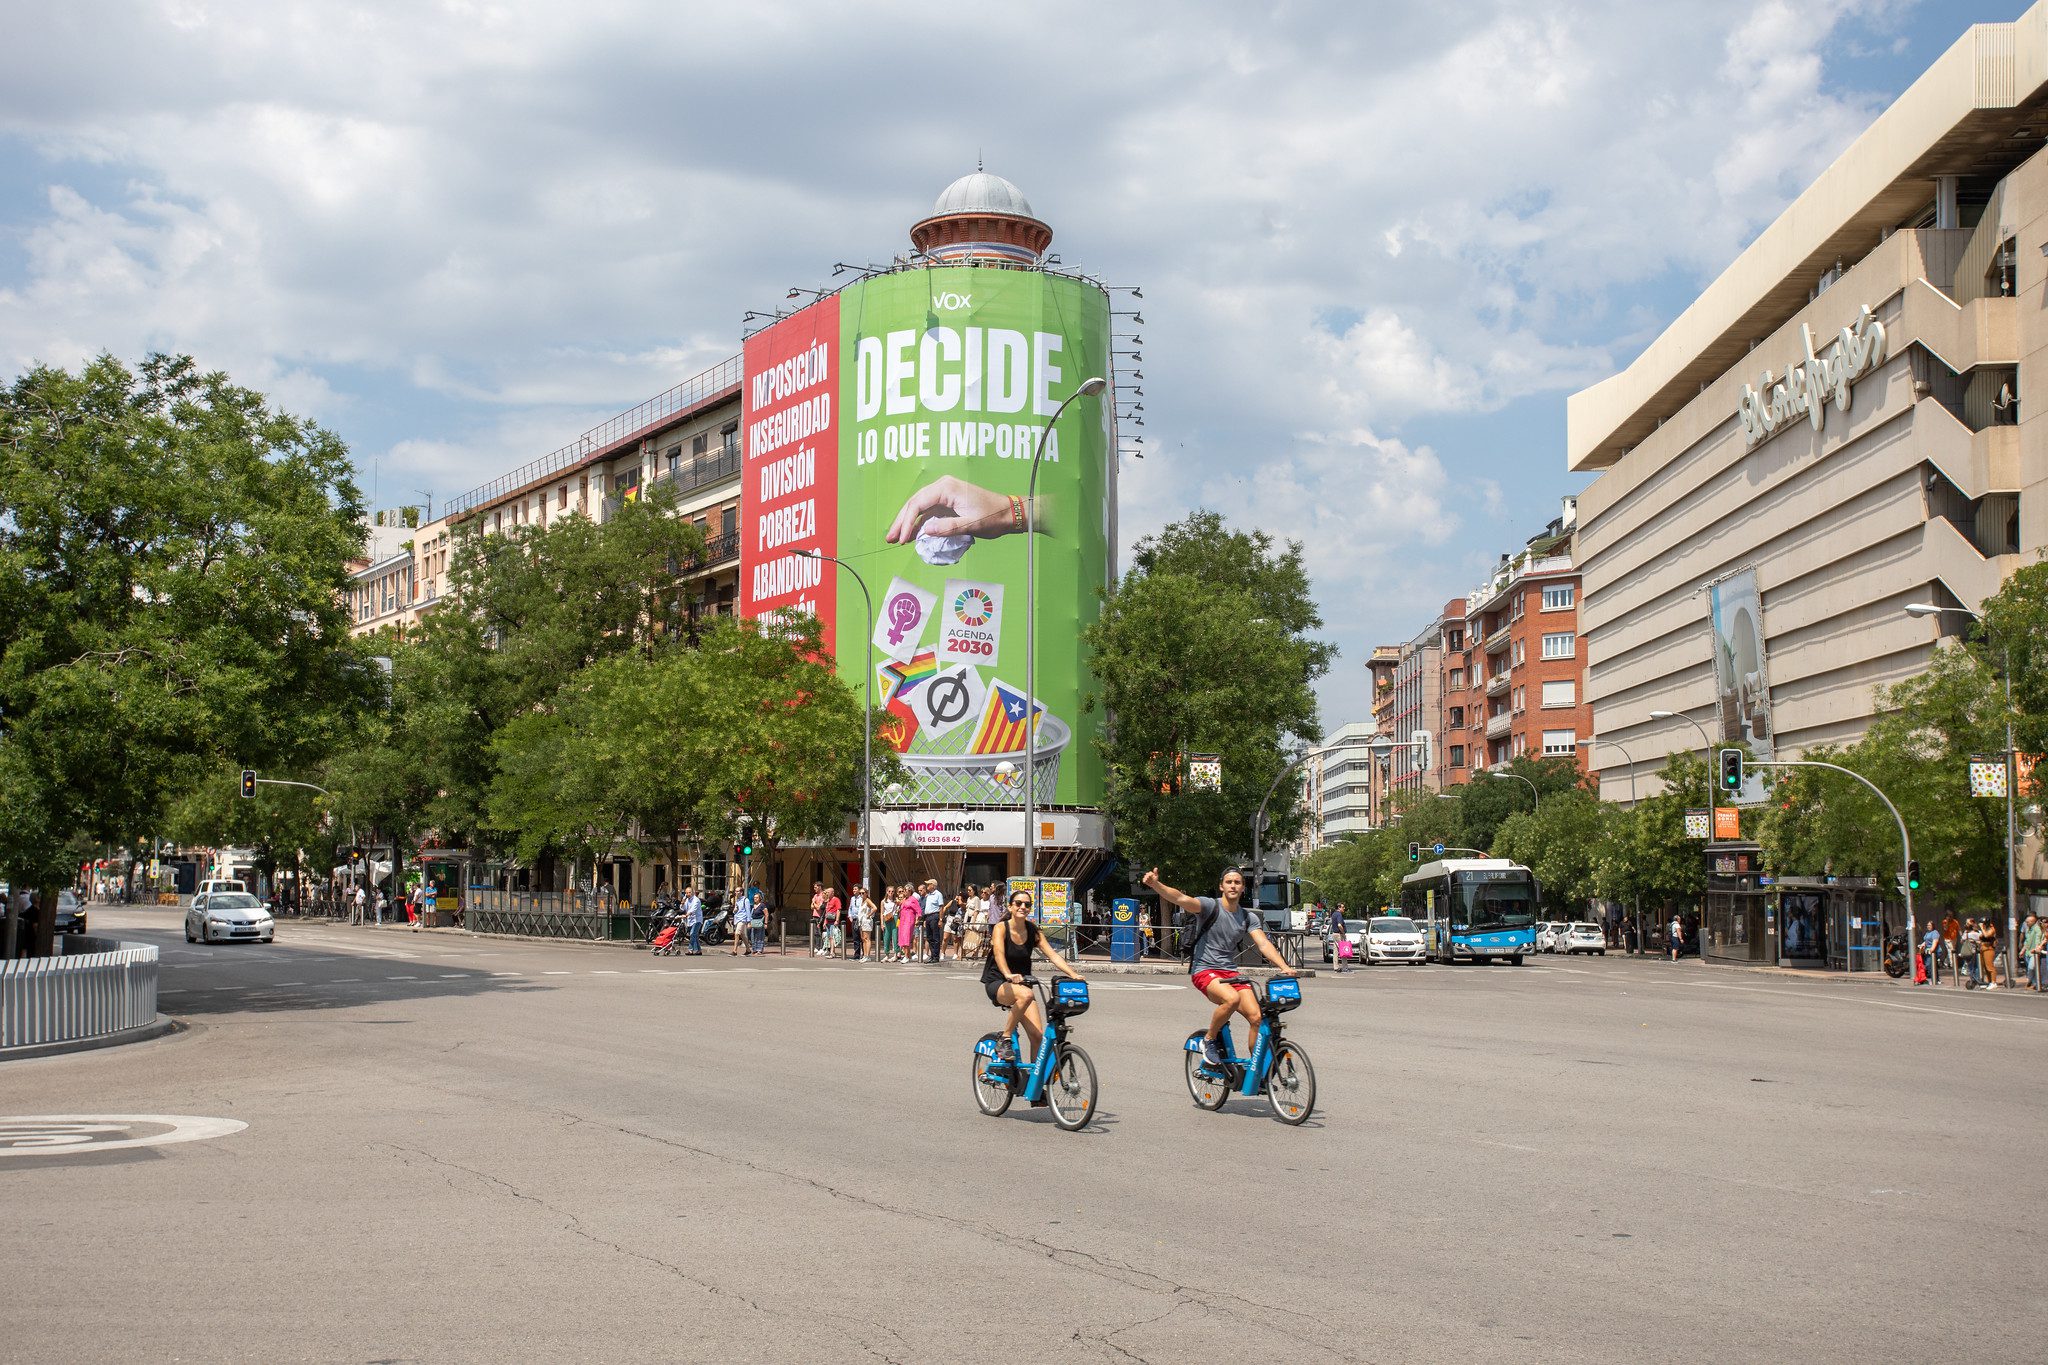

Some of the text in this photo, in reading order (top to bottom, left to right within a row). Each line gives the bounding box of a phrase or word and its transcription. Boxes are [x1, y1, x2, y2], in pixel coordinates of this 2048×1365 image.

[933, 291, 972, 311] VOX
[752, 338, 828, 412] IMPOSICIÓN
[857, 326, 1063, 422] DECIDE
[1757, 363, 1809, 432] Corte
[1800, 304, 1886, 432] Inglés
[749, 391, 830, 460] INSEGURIDAD
[858, 421, 1060, 466] LO QUE IMPORTA
[761, 442, 815, 504] DIVISIÓN
[759, 498, 816, 552] POBREZA
[752, 547, 822, 602] ABANDONO
[947, 639, 993, 656] 2030
[948, 629, 994, 641] AGENDA
[900, 819, 985, 833] pamdamedia
